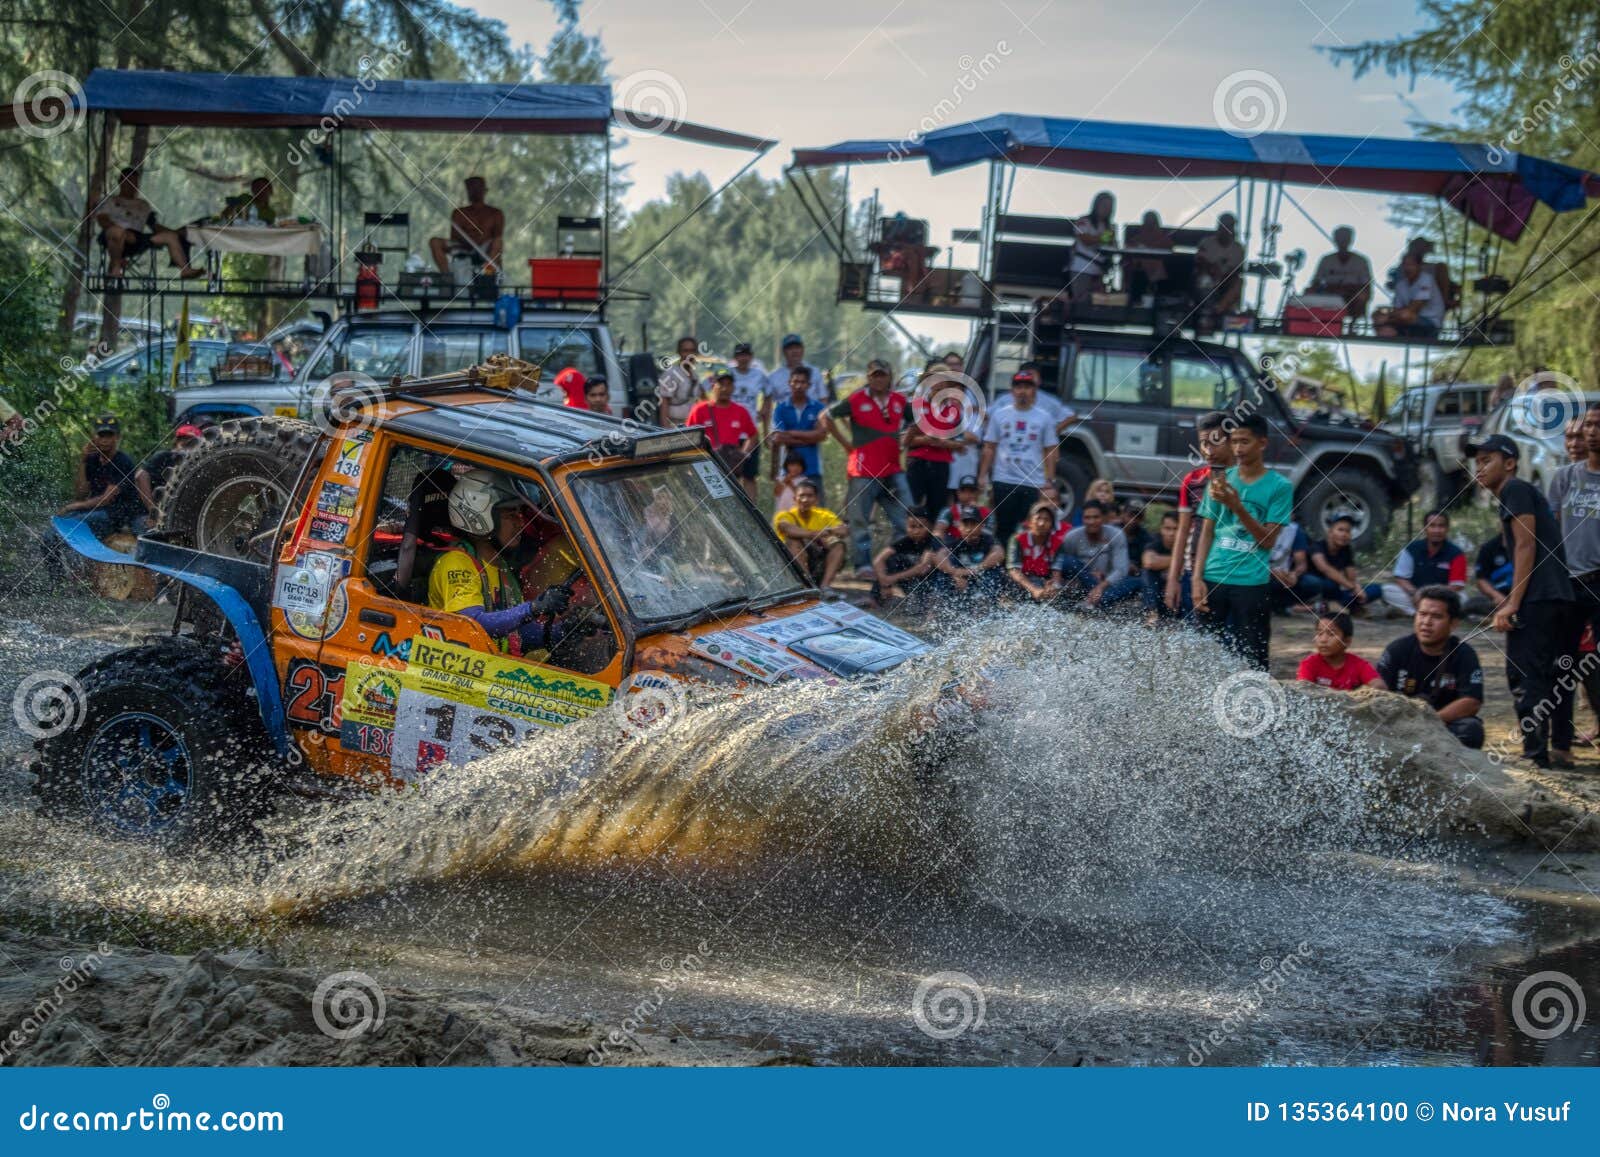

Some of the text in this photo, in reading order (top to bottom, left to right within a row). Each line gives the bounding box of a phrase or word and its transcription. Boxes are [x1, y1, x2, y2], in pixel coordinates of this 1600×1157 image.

[335, 460, 361, 478] 138
[283, 582, 319, 598] RFC'18
[414, 643, 487, 679] RFC'18
[421, 667, 451, 683] GRAND
